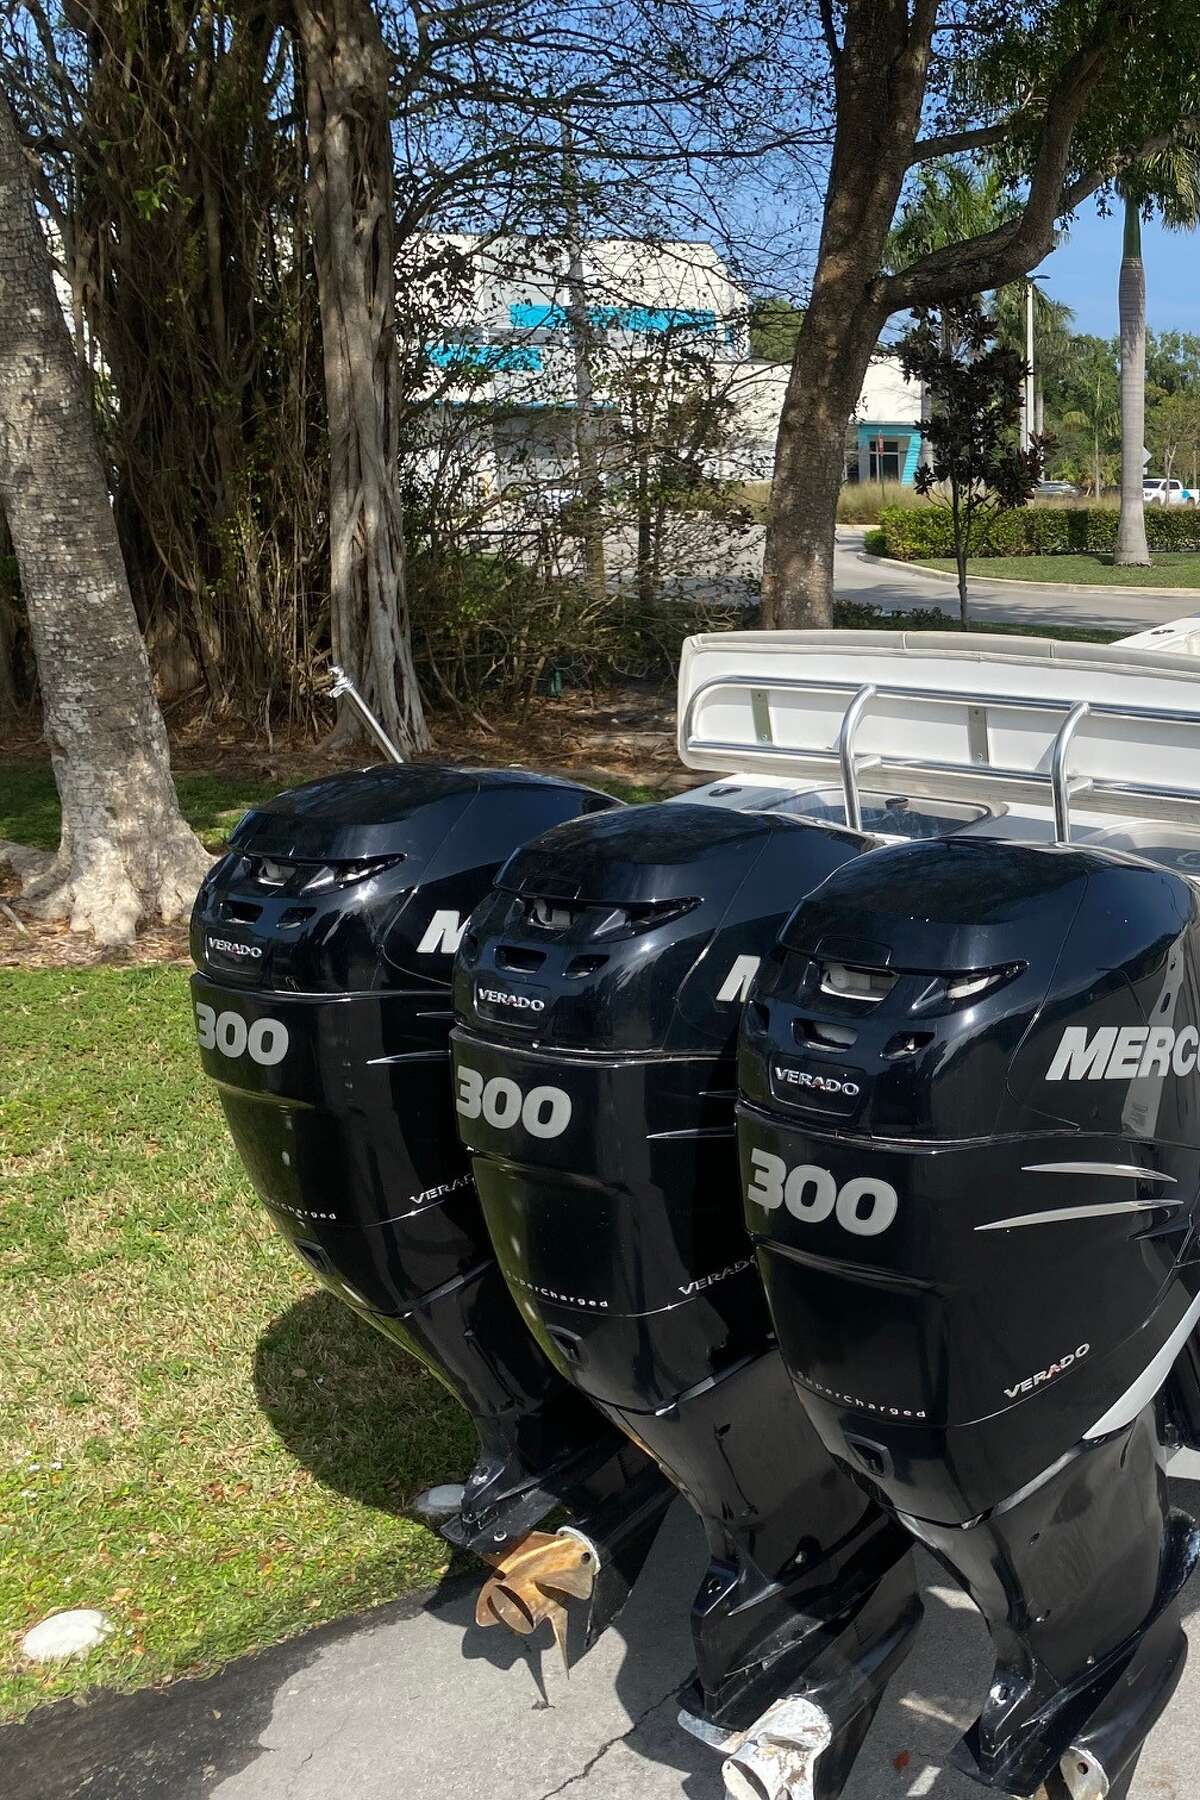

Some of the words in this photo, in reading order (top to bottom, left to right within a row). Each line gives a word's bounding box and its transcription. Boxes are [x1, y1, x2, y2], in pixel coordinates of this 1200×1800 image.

[208, 937, 262, 958] VERADO
[478, 988, 545, 1011] VERADO
[195, 1001, 289, 1066] 300
[456, 1065, 572, 1139] 300
[774, 1066, 860, 1096] VERADO
[747, 1147, 899, 1237] 300
[1003, 1343, 1090, 1398] VERADO
